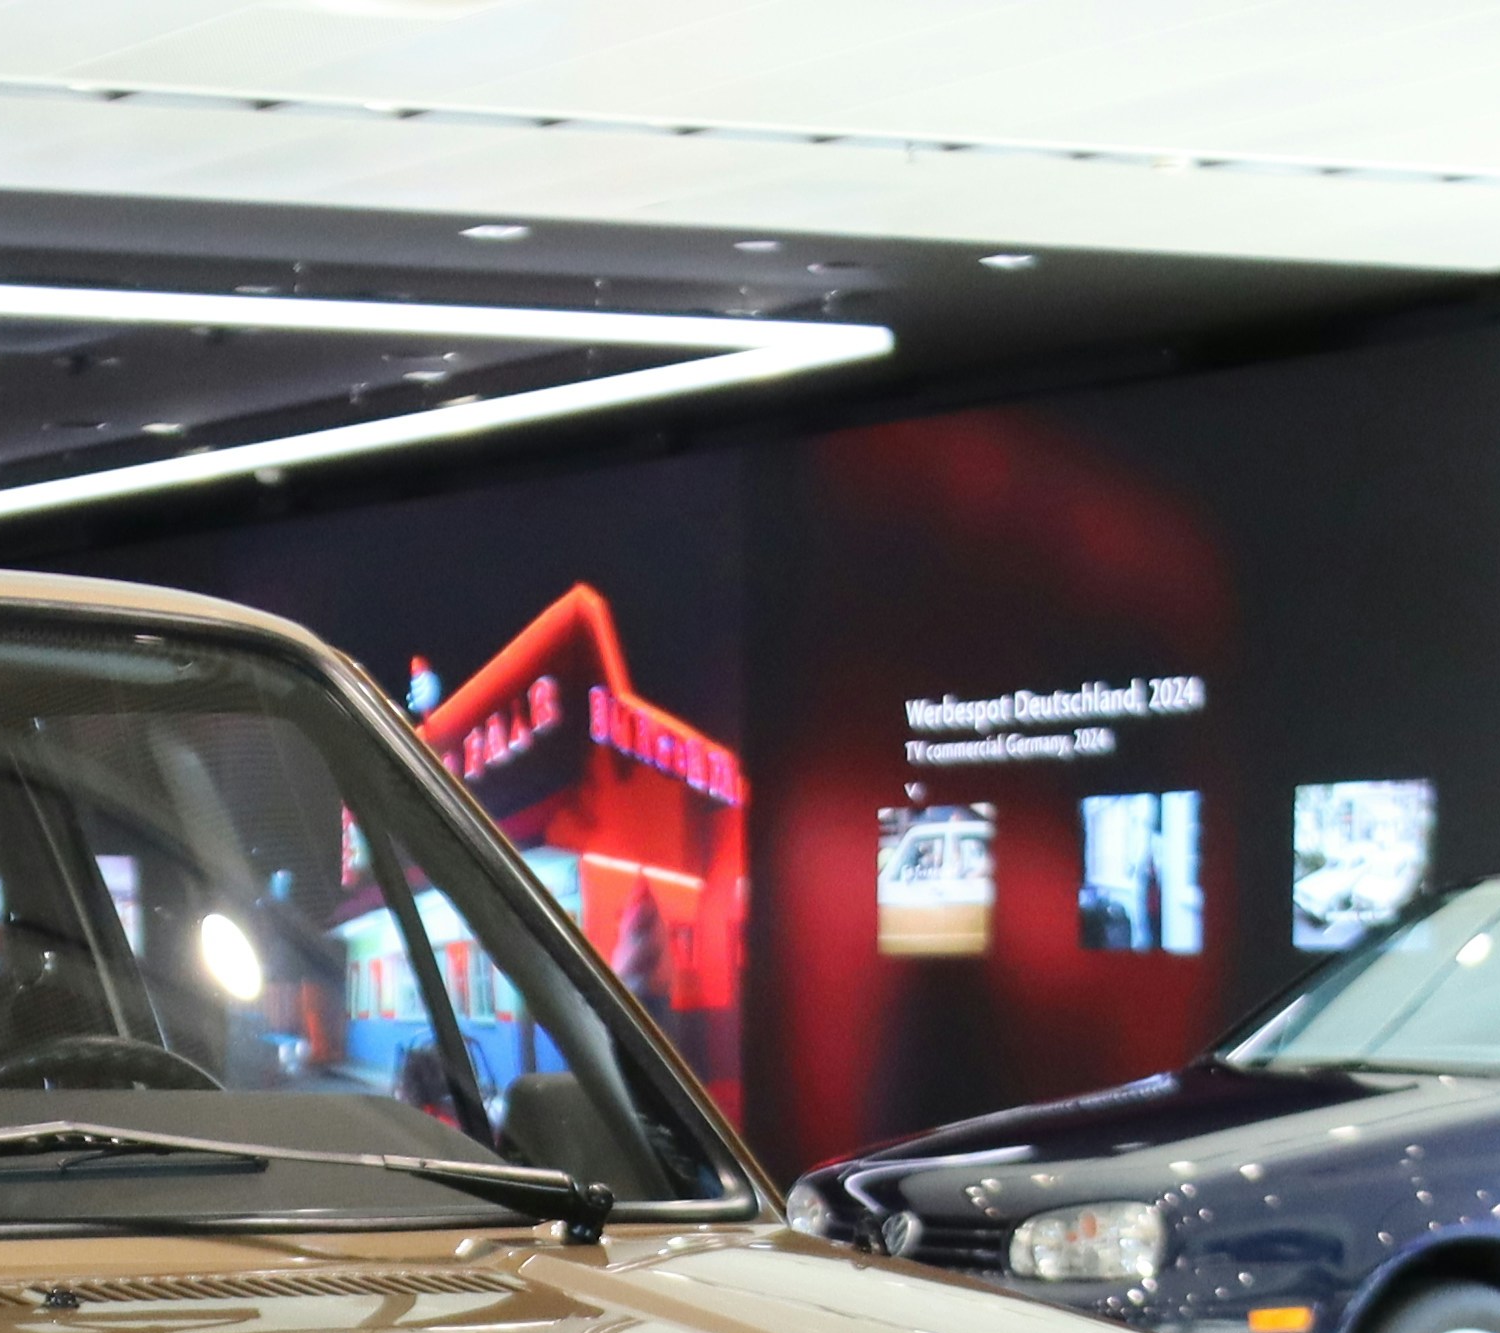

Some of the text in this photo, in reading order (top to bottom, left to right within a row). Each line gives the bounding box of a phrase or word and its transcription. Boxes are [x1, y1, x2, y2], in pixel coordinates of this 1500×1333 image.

[905, 675, 1206, 735] Werbespot Deutschland, 2024
[904, 726, 1117, 766] TV commercial Germany, 2024
